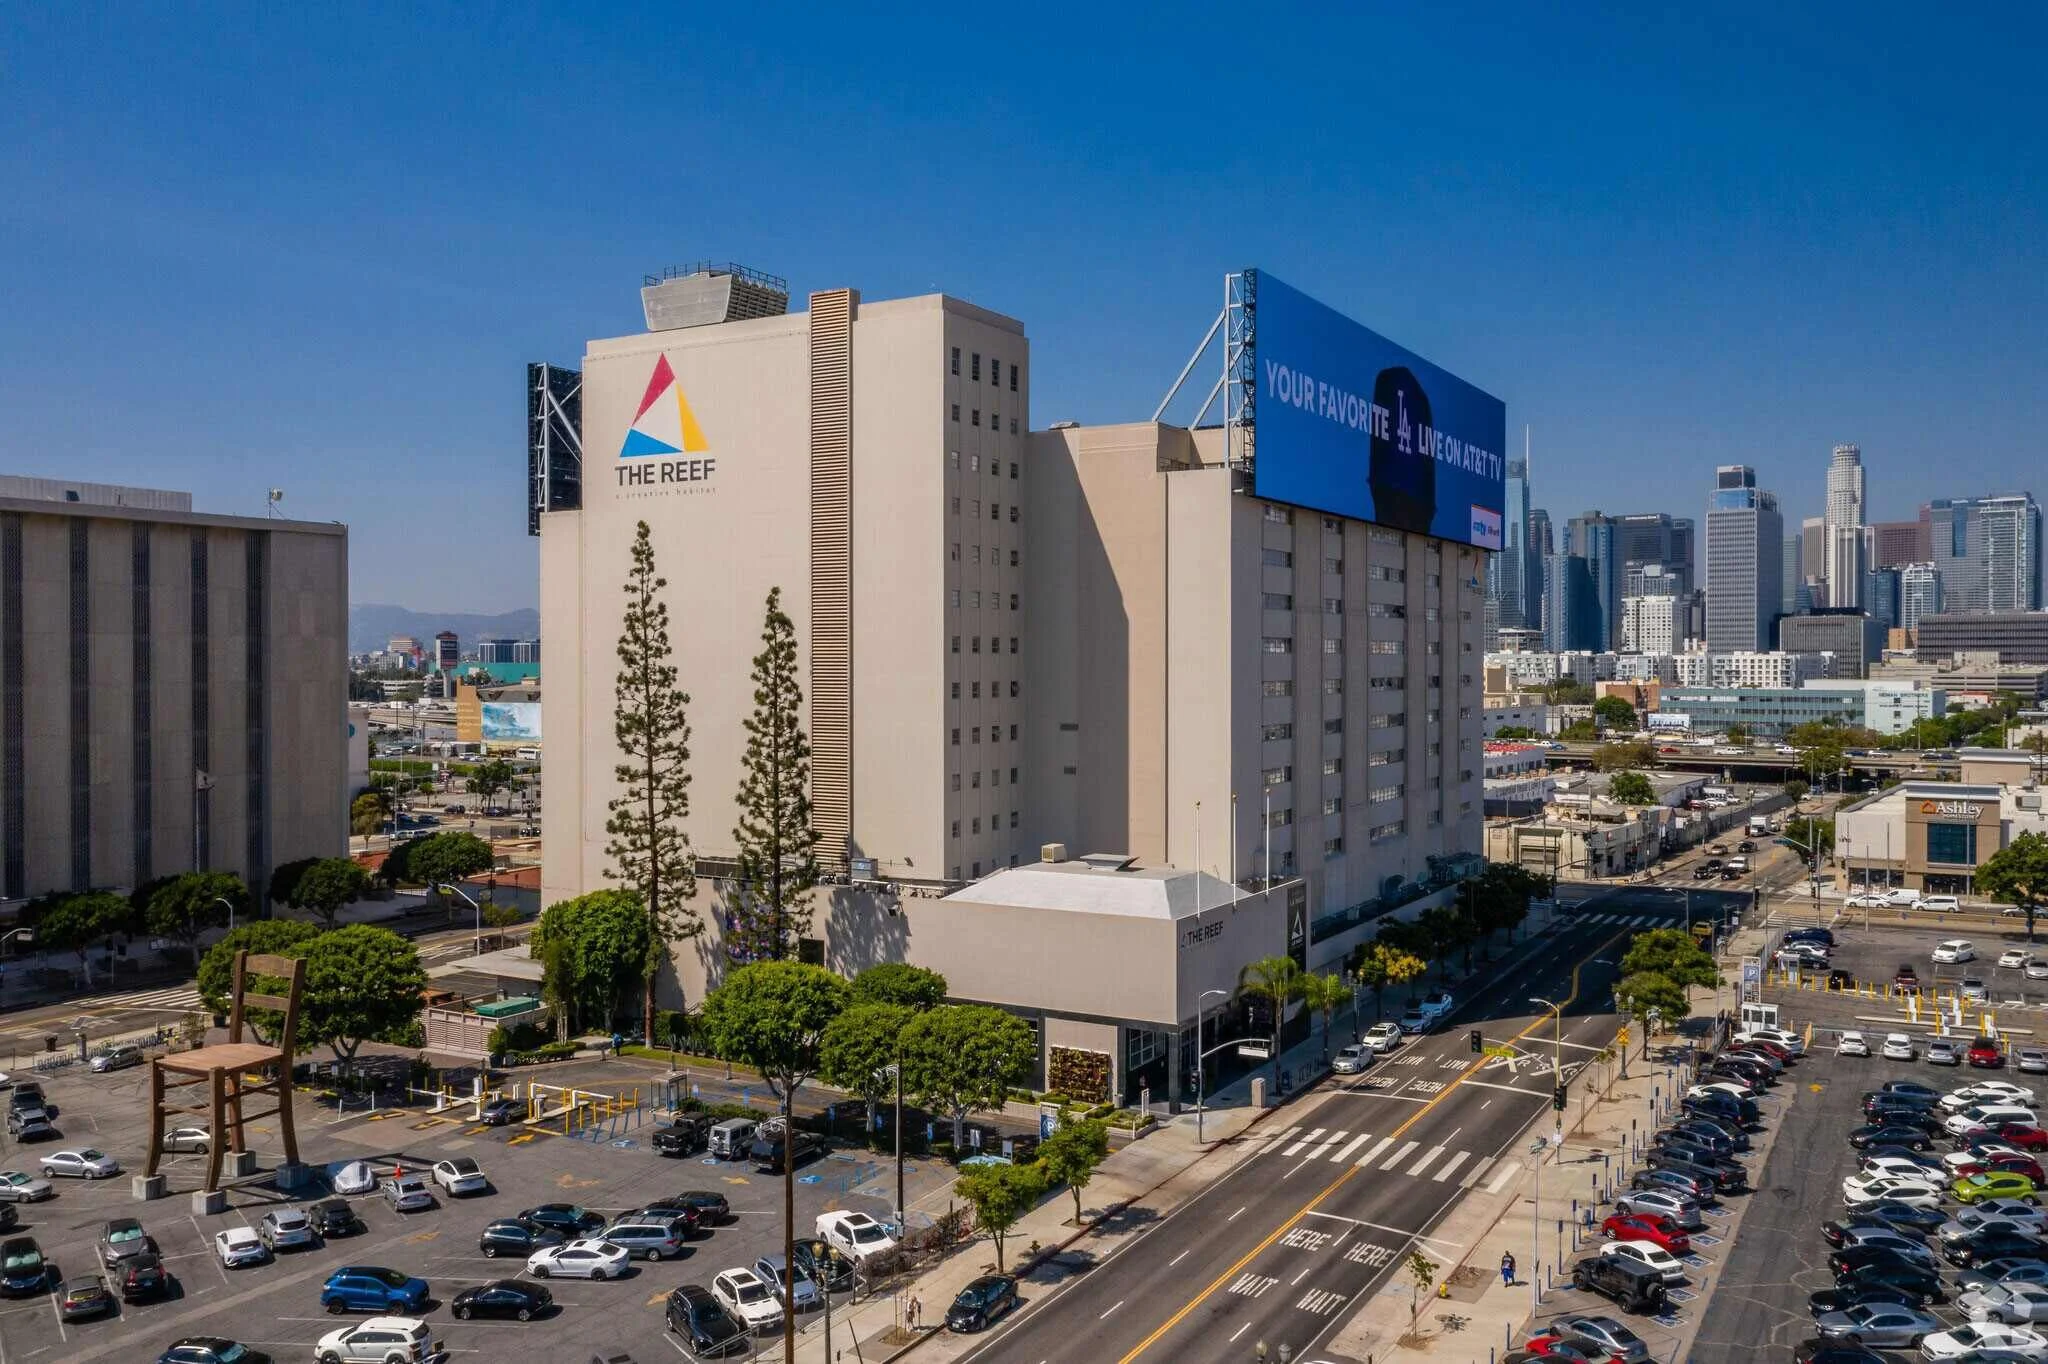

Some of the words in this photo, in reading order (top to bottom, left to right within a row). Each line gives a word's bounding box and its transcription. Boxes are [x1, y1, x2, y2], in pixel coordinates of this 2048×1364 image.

[1265, 358, 1315, 413] YOUR
[1319, 381, 1390, 441] FAVORITE
[1418, 423, 1443, 461] LIVE
[1445, 435, 1461, 467] ON
[1463, 442, 1488, 477] AT&T
[1489, 452, 1502, 482] TV
[615, 463, 655, 486] THE
[661, 458, 716, 483] REEF
[1936, 800, 1985, 819] Ashley
[1187, 927, 1203, 945] THE
[1204, 920, 1224, 939] REEF
[1279, 1227, 1333, 1252] HERE
[1343, 1241, 1397, 1268] HERE
[1228, 1272, 1280, 1298] WAIT
[1296, 1288, 1348, 1316] WAIT
